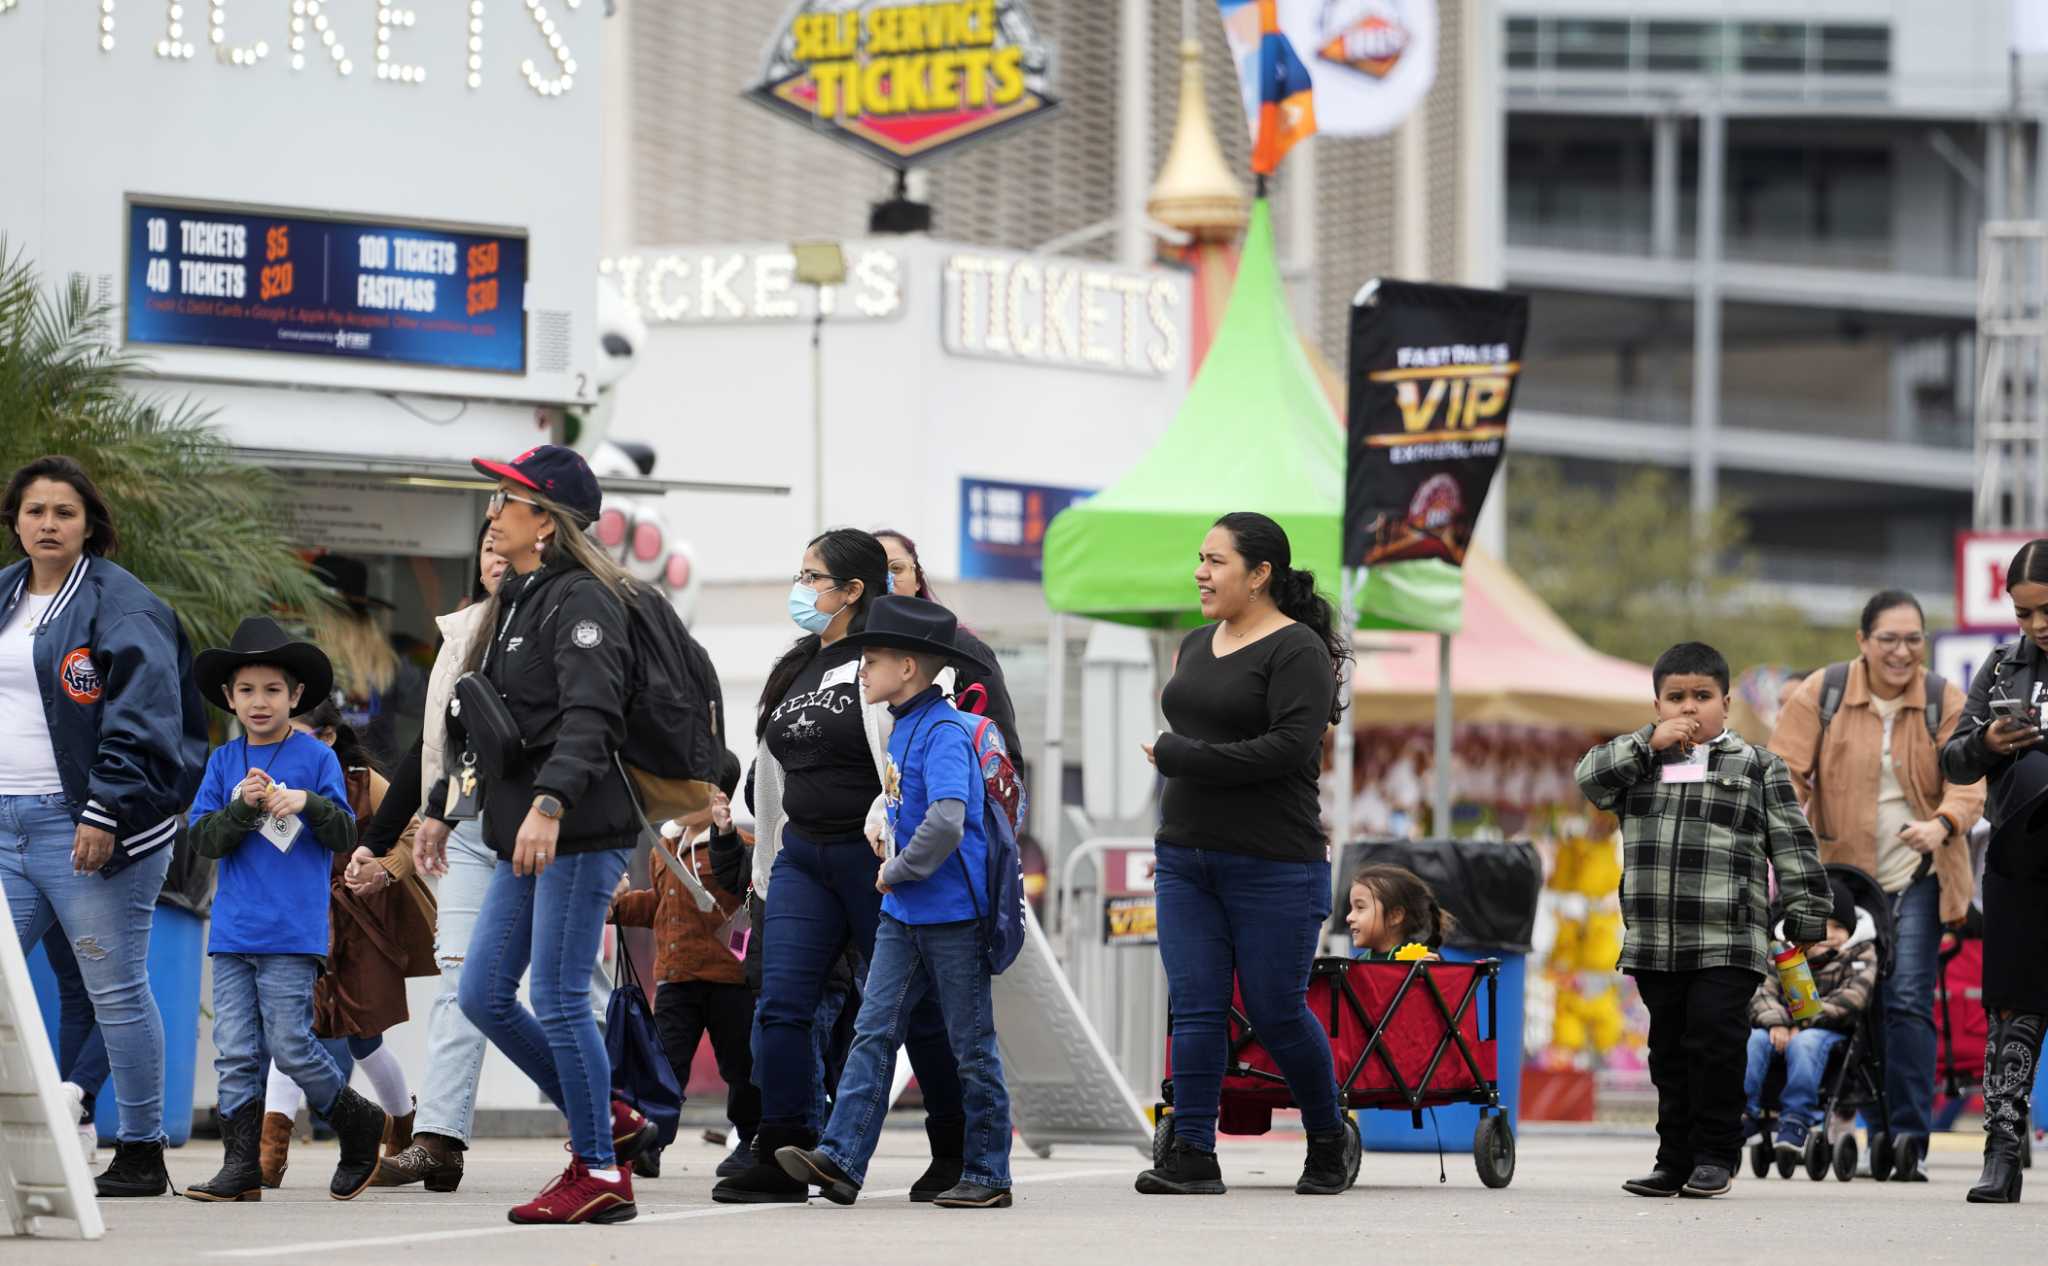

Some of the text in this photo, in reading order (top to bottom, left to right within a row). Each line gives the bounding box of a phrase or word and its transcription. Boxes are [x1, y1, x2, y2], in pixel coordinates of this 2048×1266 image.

[793, 0, 995, 60] SELF SERVICE
[810, 44, 1027, 119] TICKETS
[147, 217, 290, 262] 10 TICKETS $5
[358, 234, 499, 280] 100 TICKETS $50
[146, 258, 294, 301] 40 TICKETS $20
[356, 273, 437, 313] FASTPASS
[599, 250, 900, 319] ICKES
[946, 253, 1180, 373] TICKETS
[576, 372, 587, 398] 2
[1394, 376, 1511, 433] VIP
[64, 662, 101, 693] Astro
[770, 689, 855, 722] TEXAS
